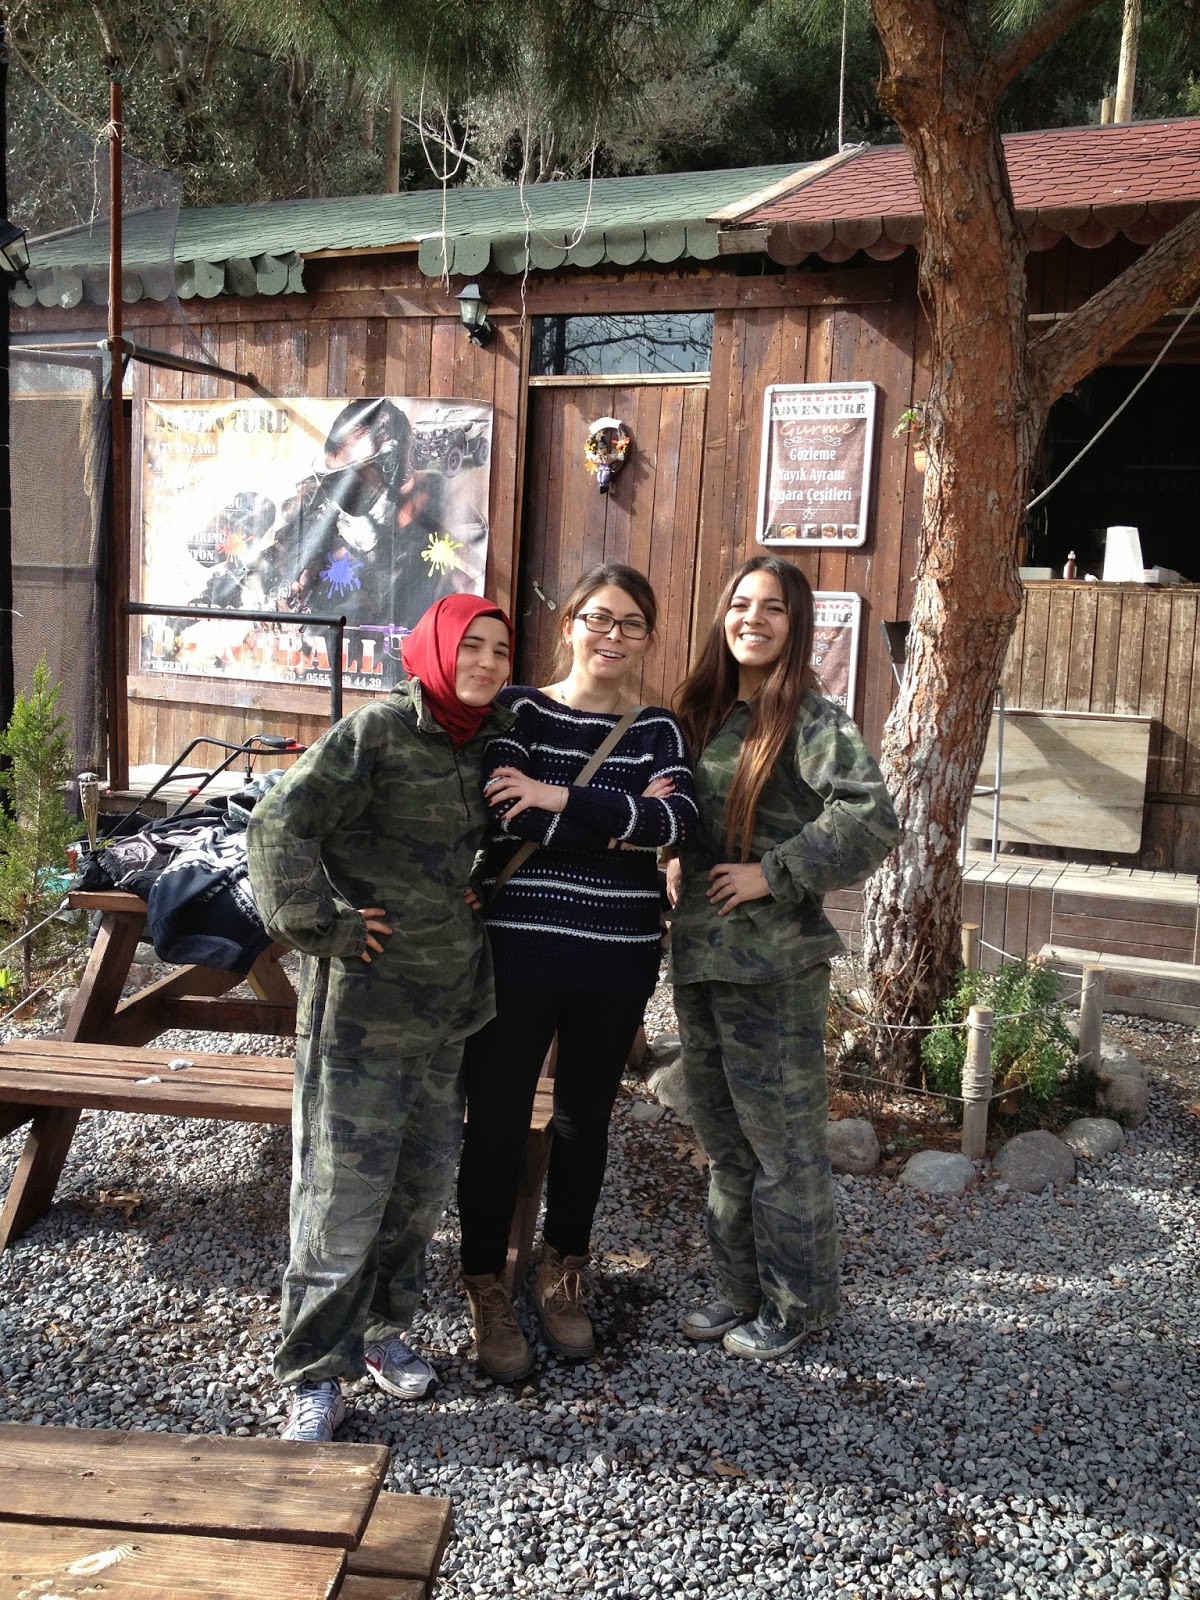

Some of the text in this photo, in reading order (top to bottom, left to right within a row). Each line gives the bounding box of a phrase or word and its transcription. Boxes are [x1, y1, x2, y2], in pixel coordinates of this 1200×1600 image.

[772, 403, 866, 416] ADVENTURE
[779, 420, 856, 437] Gurme
[789, 447, 836, 461] Gözleme
[806, 486, 853, 505] Çeşitleri
[305, 672, 331, 684] 0555
[353, 676, 366, 687] 44
[370, 677, 382, 689] 39
